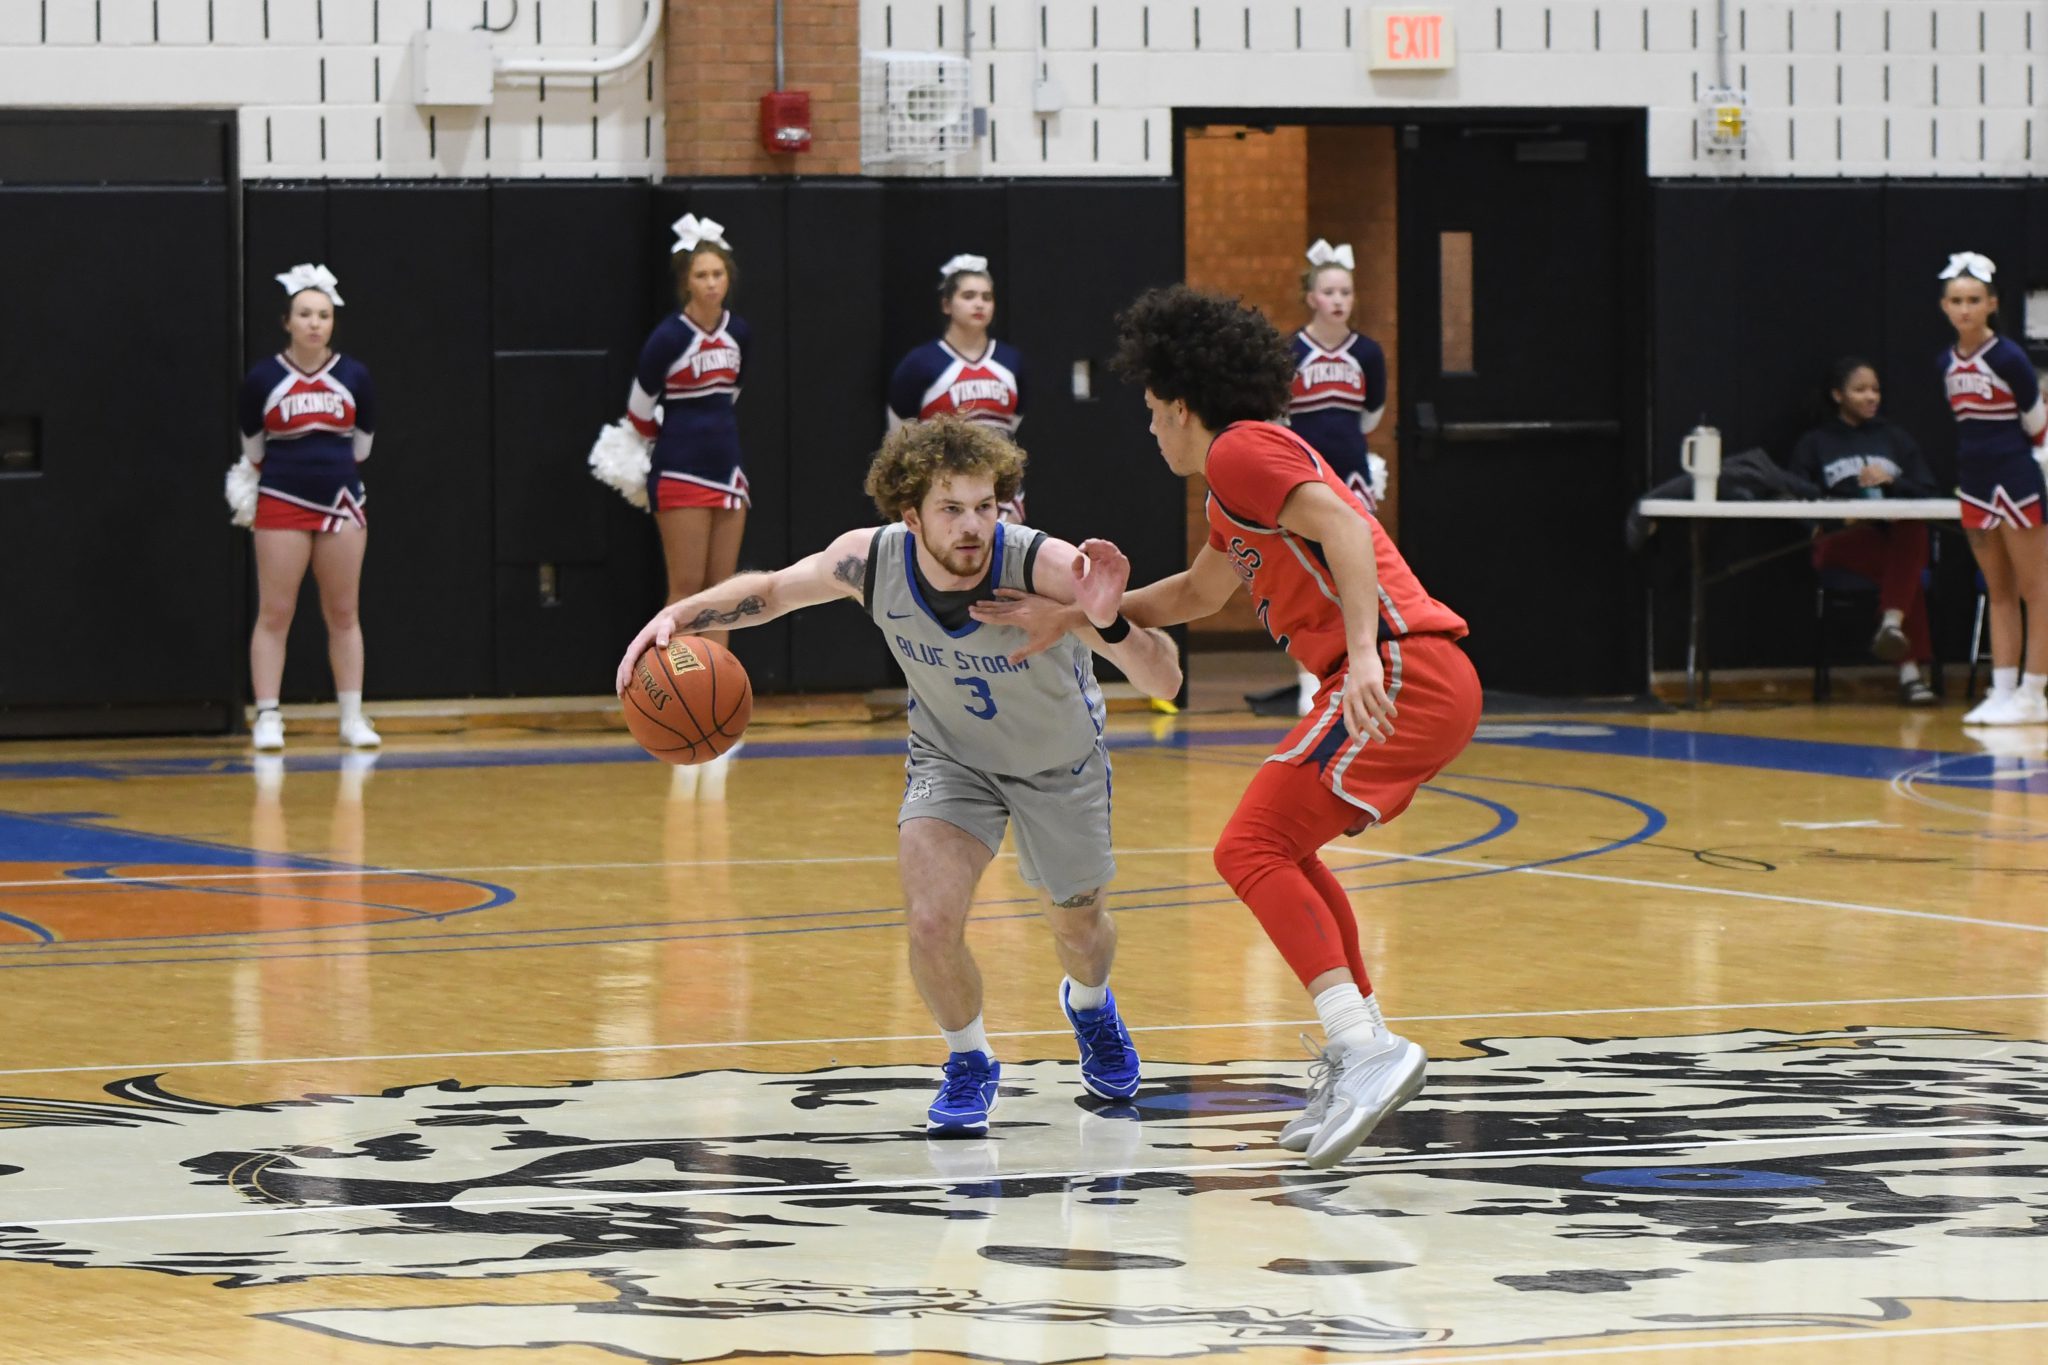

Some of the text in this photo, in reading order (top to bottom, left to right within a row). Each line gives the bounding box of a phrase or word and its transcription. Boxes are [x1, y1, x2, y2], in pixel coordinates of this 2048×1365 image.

[1387, 15, 1443, 60] EXIT
[1303, 362, 1361, 390] VIKINGS
[280, 391, 343, 423] VIKINGS
[949, 379, 1010, 407] VIKINGS
[895, 634, 950, 668] BLUE
[954, 676, 998, 720] 3
